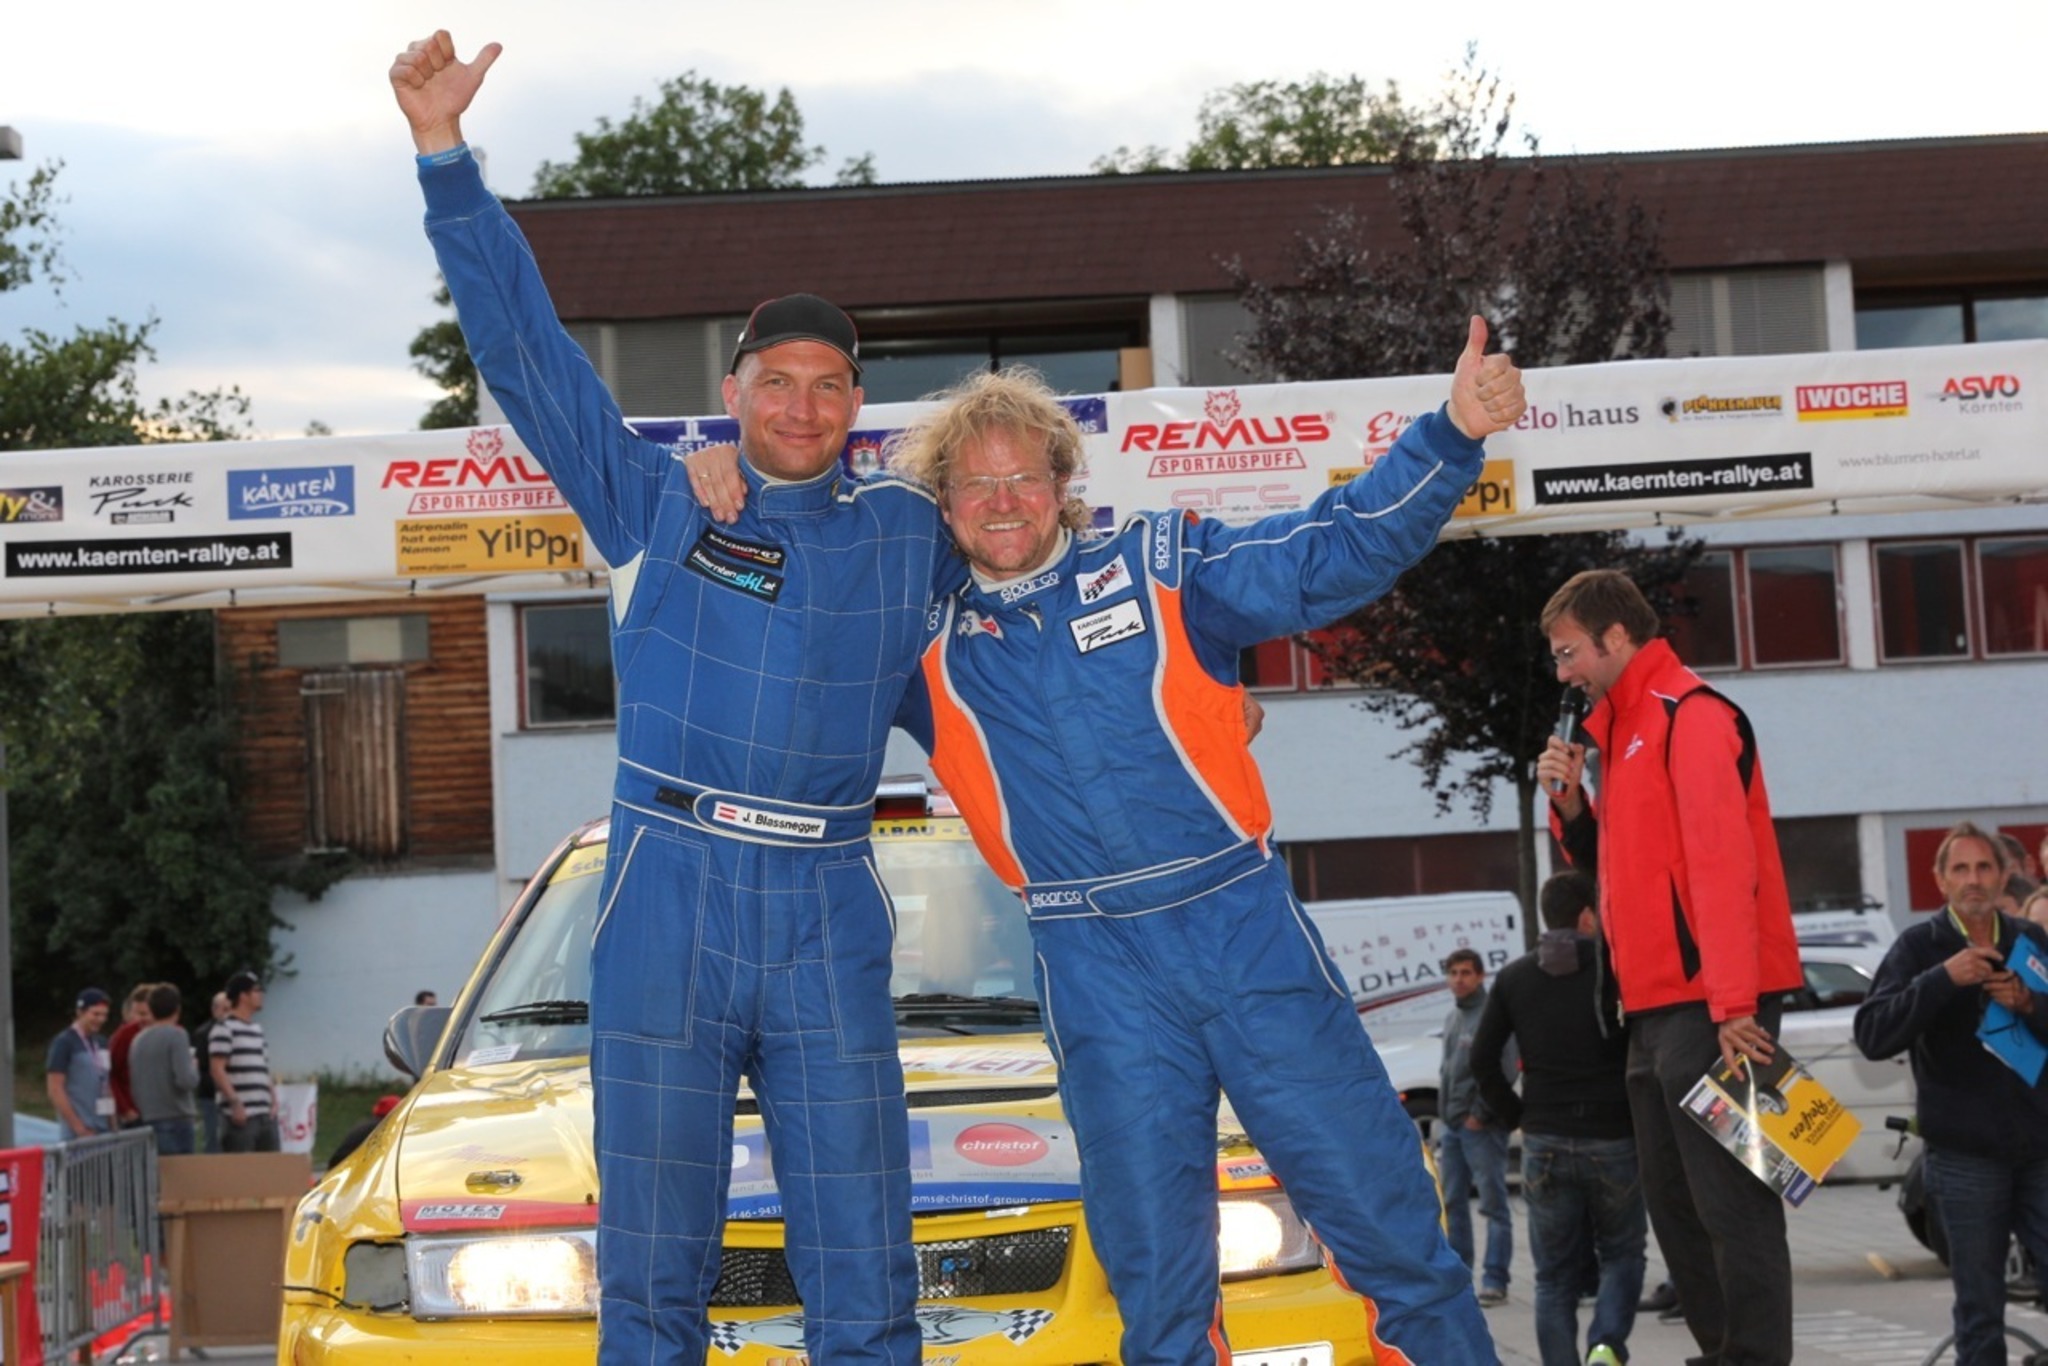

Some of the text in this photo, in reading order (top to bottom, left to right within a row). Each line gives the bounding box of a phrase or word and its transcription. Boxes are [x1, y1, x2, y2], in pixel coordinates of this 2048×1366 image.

[1807, 383, 1905, 409] WOCHE
[1514, 403, 1640, 430] elo haus
[1121, 415, 1330, 453] REMUS
[1158, 451, 1295, 474] SPORTAUSPUFF
[1838, 448, 1981, 468] www.blumen-hotel.at
[89, 472, 194, 487] KAROSSERIE
[381, 456, 556, 489] REMU
[1544, 461, 1804, 496] www.kaernten-rallye.at
[280, 503, 332, 518] SPORT
[418, 490, 557, 511] SPORTAUSPUFF
[400, 521, 469, 533] Adrenalin
[400, 545, 451, 555] Namen
[478, 520, 579, 565] Yiippi
[17, 541, 281, 569] www.kaernten-rallye.at
[743, 813, 821, 834] J. Blassnegger
[1413, 917, 1503, 942] STAHL
[1361, 932, 1507, 966] ESIGN
[961, 1139, 1042, 1151] christof
